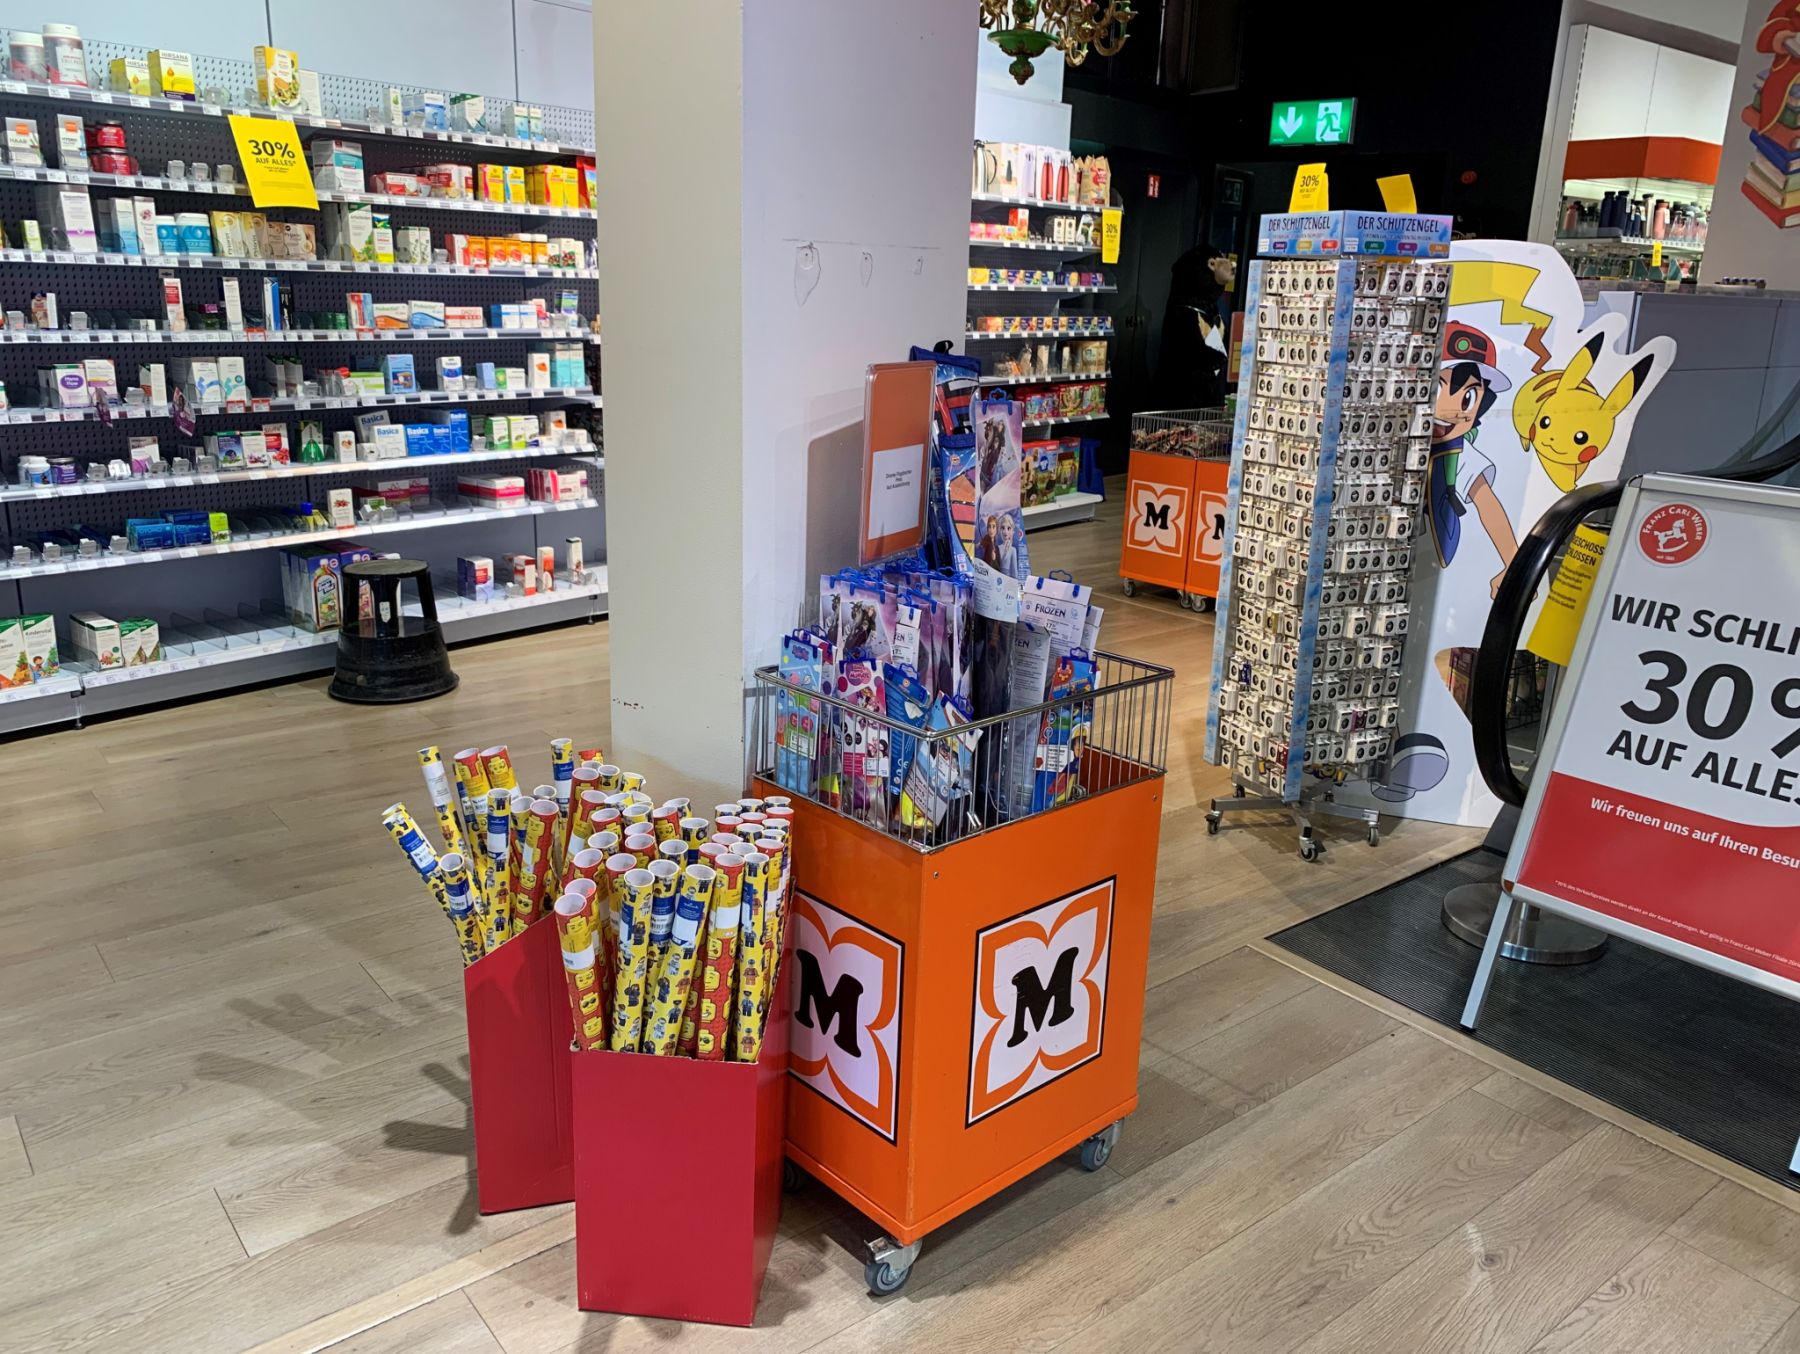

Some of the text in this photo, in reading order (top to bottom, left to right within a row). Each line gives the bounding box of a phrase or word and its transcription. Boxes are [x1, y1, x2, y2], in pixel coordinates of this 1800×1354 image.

[248, 139, 296, 159] 30%
[255, 157, 270, 165] AUF
[1300, 174, 1320, 188] 30%
[1268, 215, 1330, 232] DER SCHUTZENGEL
[1357, 216, 1440, 233] DER SCHUTZENGEL
[361, 414, 385, 424] Basica
[376, 428, 399, 436] Basica
[406, 427, 429, 435] Basica
[1143, 502, 1171, 530] M
[1035, 603, 1066, 618] FROZEN
[1611, 593, 1681, 633] WIR
[1606, 729, 1800, 807] AUF ALLE
[1591, 797, 1800, 869] Wir freuen uns auf Ihren Besu
[795, 948, 864, 1059] M
[1007, 946, 1080, 1049] M
